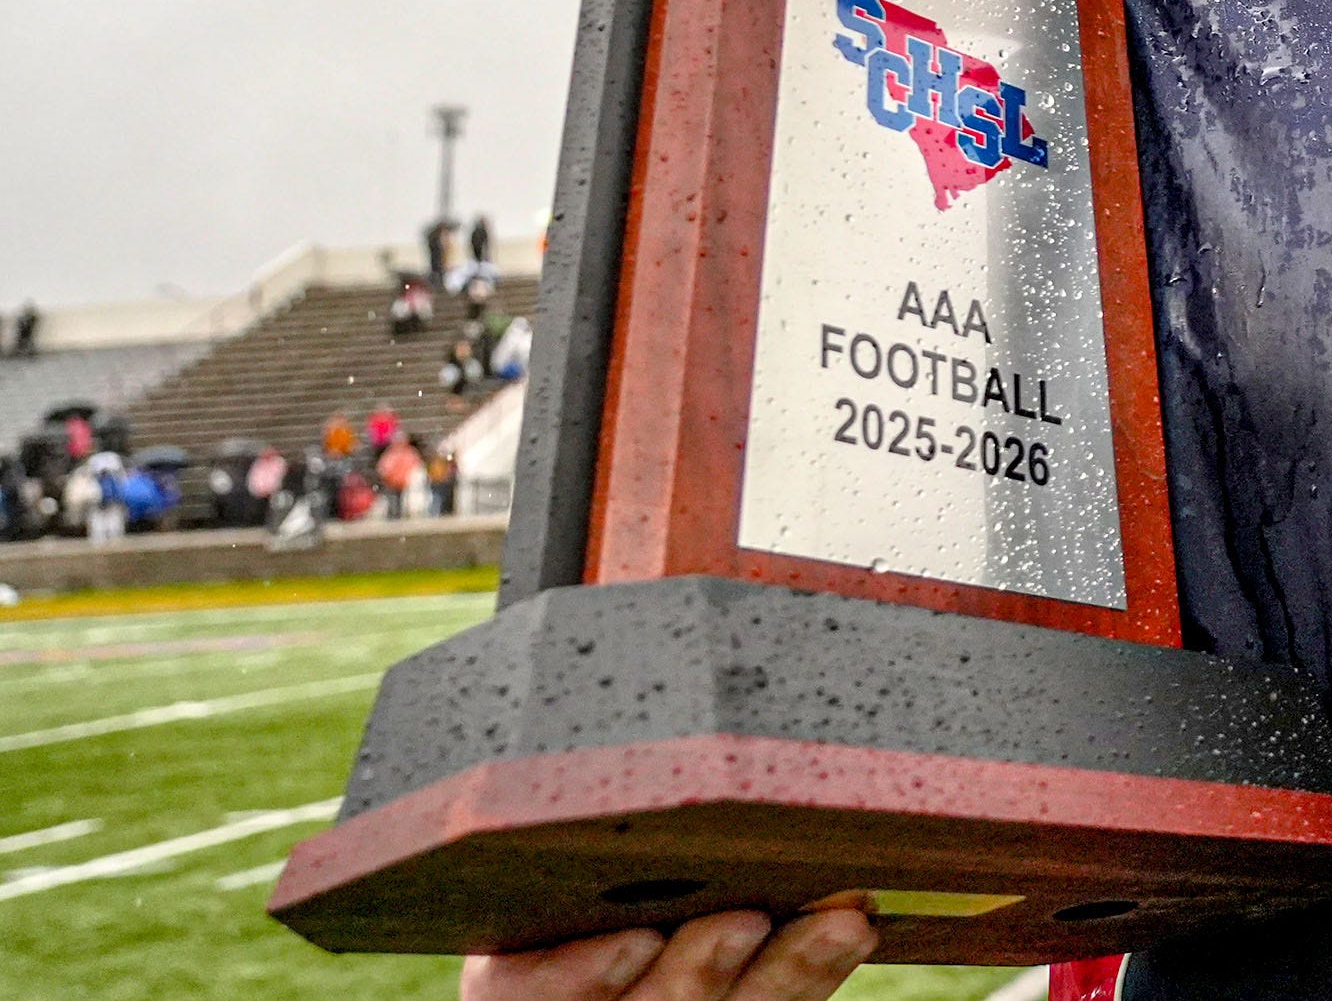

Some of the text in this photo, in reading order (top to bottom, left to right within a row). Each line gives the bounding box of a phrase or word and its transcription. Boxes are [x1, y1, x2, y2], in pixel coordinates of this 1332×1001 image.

[897, 281, 993, 344] AAA
[820, 323, 1062, 425] FOOTBALL
[834, 397, 1050, 487] 2025-2026
